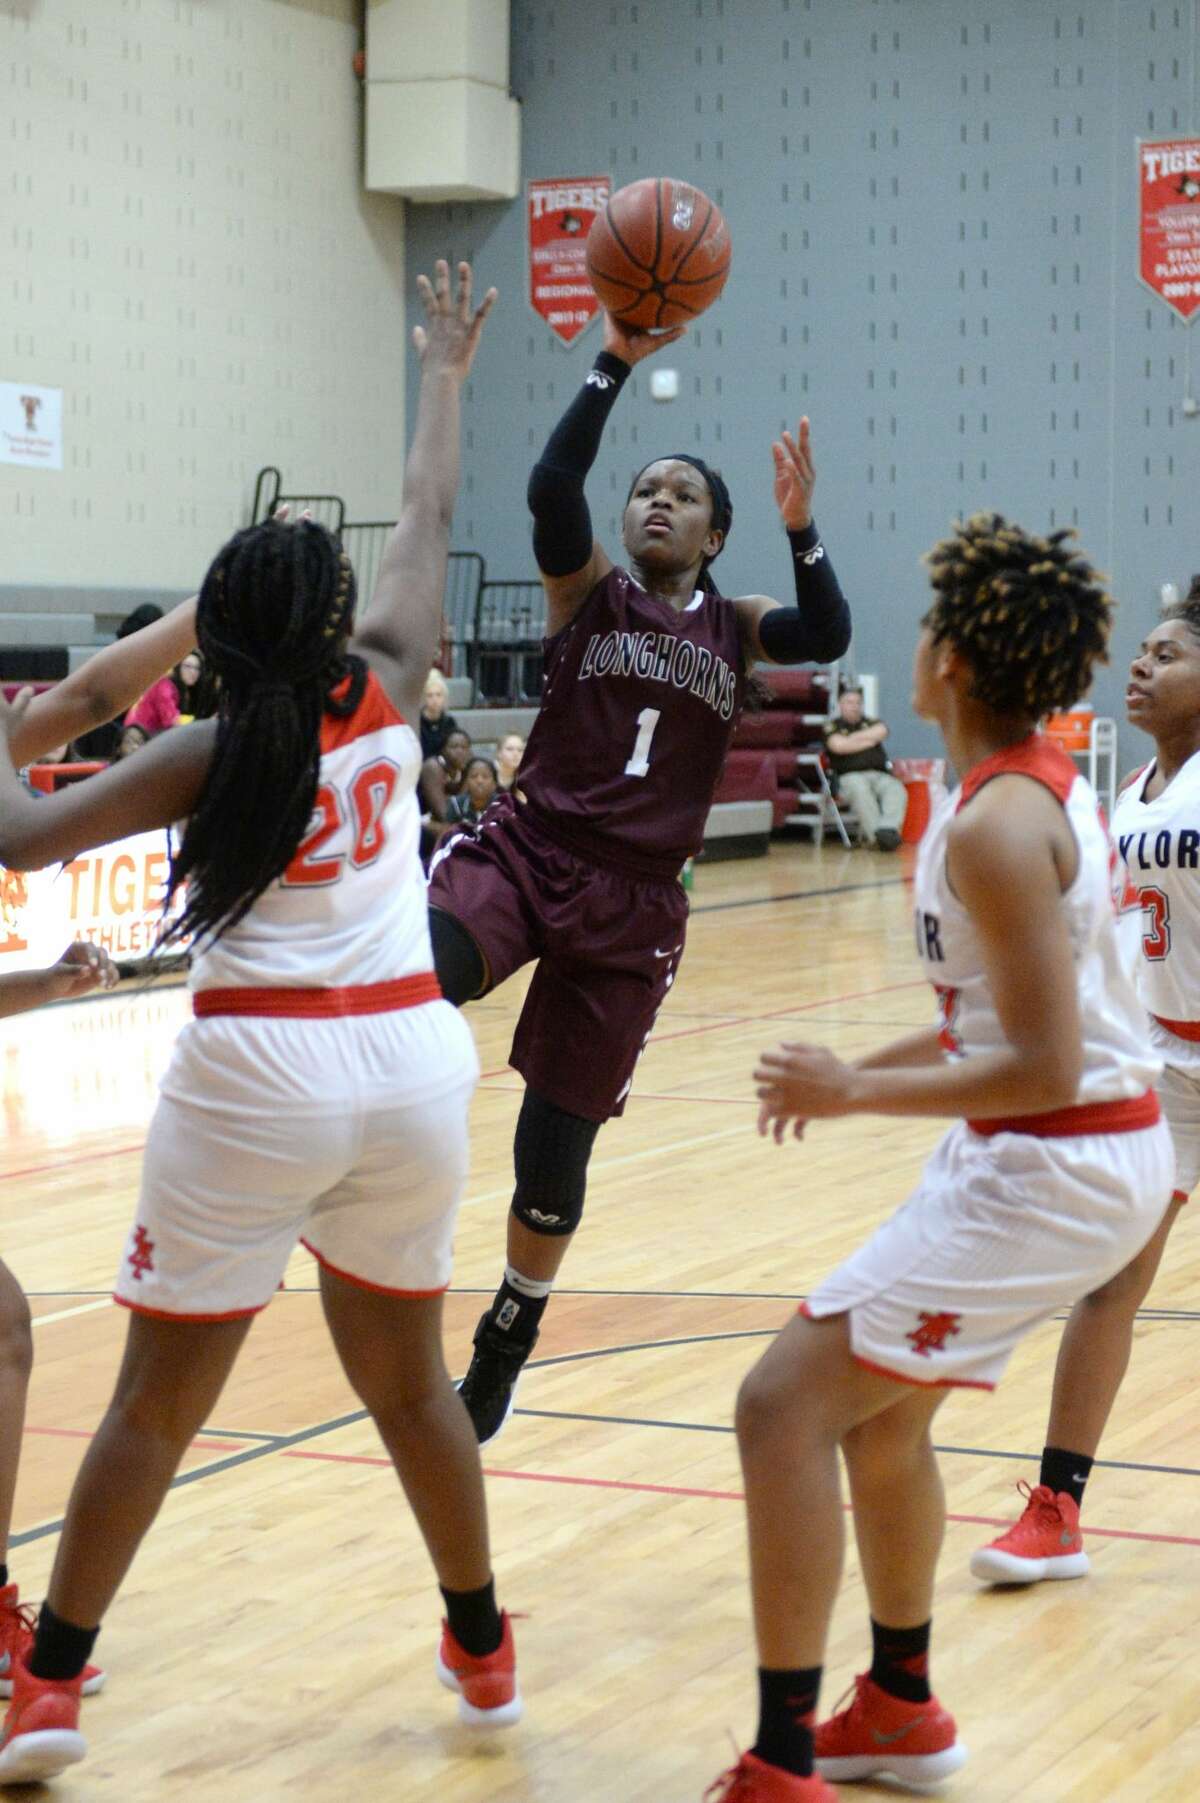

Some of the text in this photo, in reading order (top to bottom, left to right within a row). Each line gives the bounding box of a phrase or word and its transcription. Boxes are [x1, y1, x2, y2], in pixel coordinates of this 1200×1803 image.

[531, 187, 608, 220] TIGERS
[578, 629, 736, 721] LONGHORNS
[624, 706, 661, 777] 1
[280, 755, 401, 888] 20
[63, 853, 190, 920] TIGE
